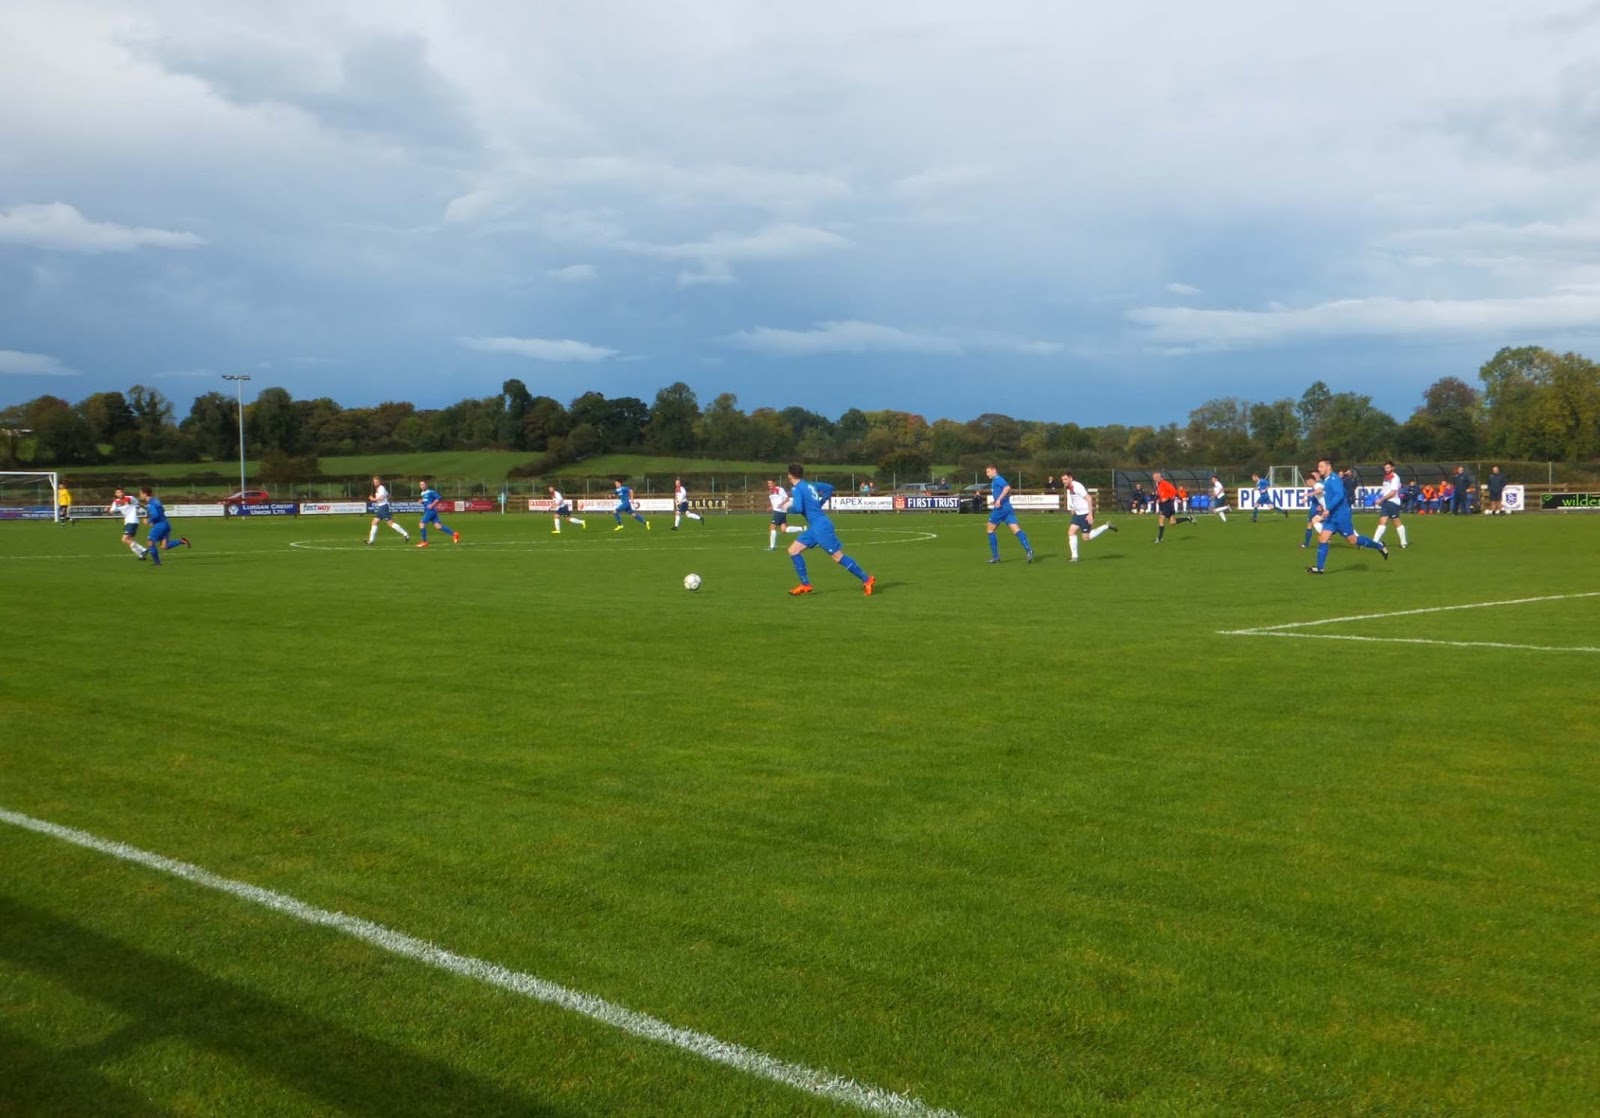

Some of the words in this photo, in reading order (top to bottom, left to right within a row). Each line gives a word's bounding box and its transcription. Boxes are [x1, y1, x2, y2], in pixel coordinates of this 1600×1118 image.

[907, 497, 932, 508] FIRST
[933, 497, 958, 508] TRUST
[1241, 489, 1314, 507] PLNTE
[303, 503, 331, 512] fastway
